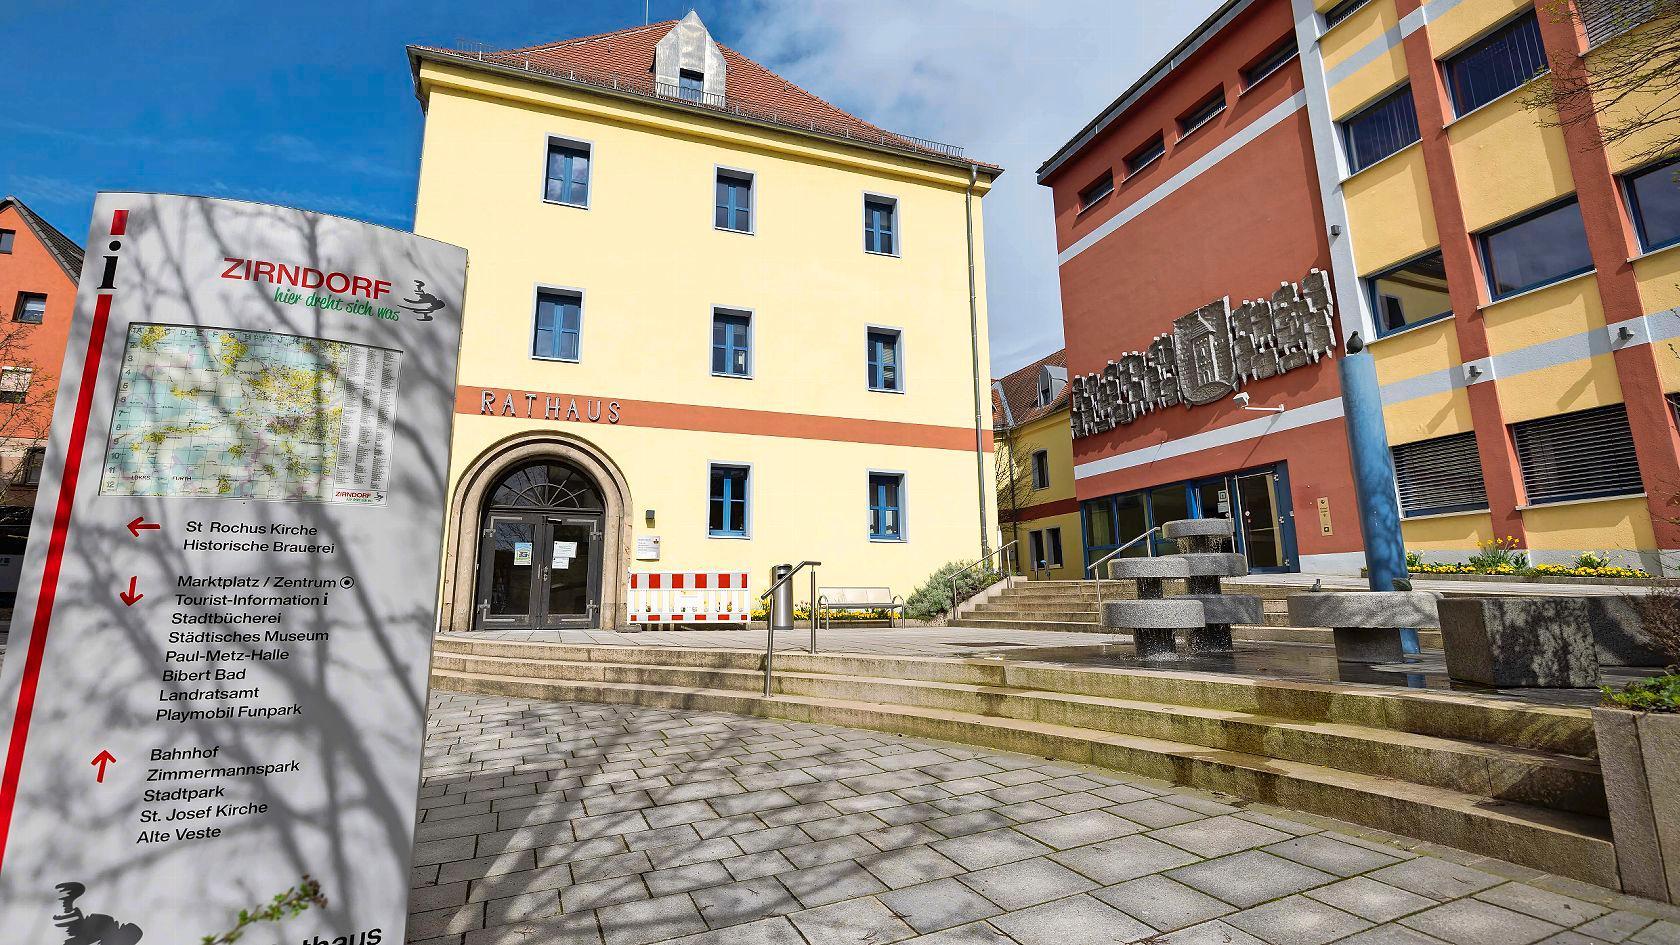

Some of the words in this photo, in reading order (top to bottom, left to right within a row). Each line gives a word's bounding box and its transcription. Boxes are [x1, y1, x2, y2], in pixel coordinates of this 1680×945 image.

[220, 257, 392, 300] ZIRNDORF
[274, 286, 302, 305] hier
[305, 292, 343, 311] dreht
[345, 300, 373, 317] sich
[377, 306, 401, 322] was
[481, 390, 621, 424] RATHAUS
[210, 521, 267, 534] Rochus
[270, 523, 318, 535] Kirche
[184, 538, 270, 551] Historische
[273, 541, 335, 553] Brauerei
[178, 575, 260, 589] Marktplatz
[273, 576, 337, 588] Zentrum
[175, 592, 320, 605] Tourist-Information
[172, 612, 282, 624] Stadtbücherei
[169, 630, 261, 643] Städtisches
[265, 630, 329, 642] Museum
[166, 648, 290, 662] Paul-Metz-Halle
[163, 669, 212, 681] Bibert
[215, 668, 247, 680] Bad
[160, 687, 260, 701] Landratsamt
[156, 706, 235, 723] Playmobil
[238, 703, 303, 719] Funpark
[151, 745, 220, 760] Bahnhof
[147, 760, 300, 781] Zimmermannspark
[144, 785, 226, 802] Stadtpark
[140, 809, 162, 822] St.
[166, 805, 213, 821] Josef
[216, 802, 268, 817] Kirche
[137, 830, 171, 843] Alte
[176, 826, 222, 840] Veste
